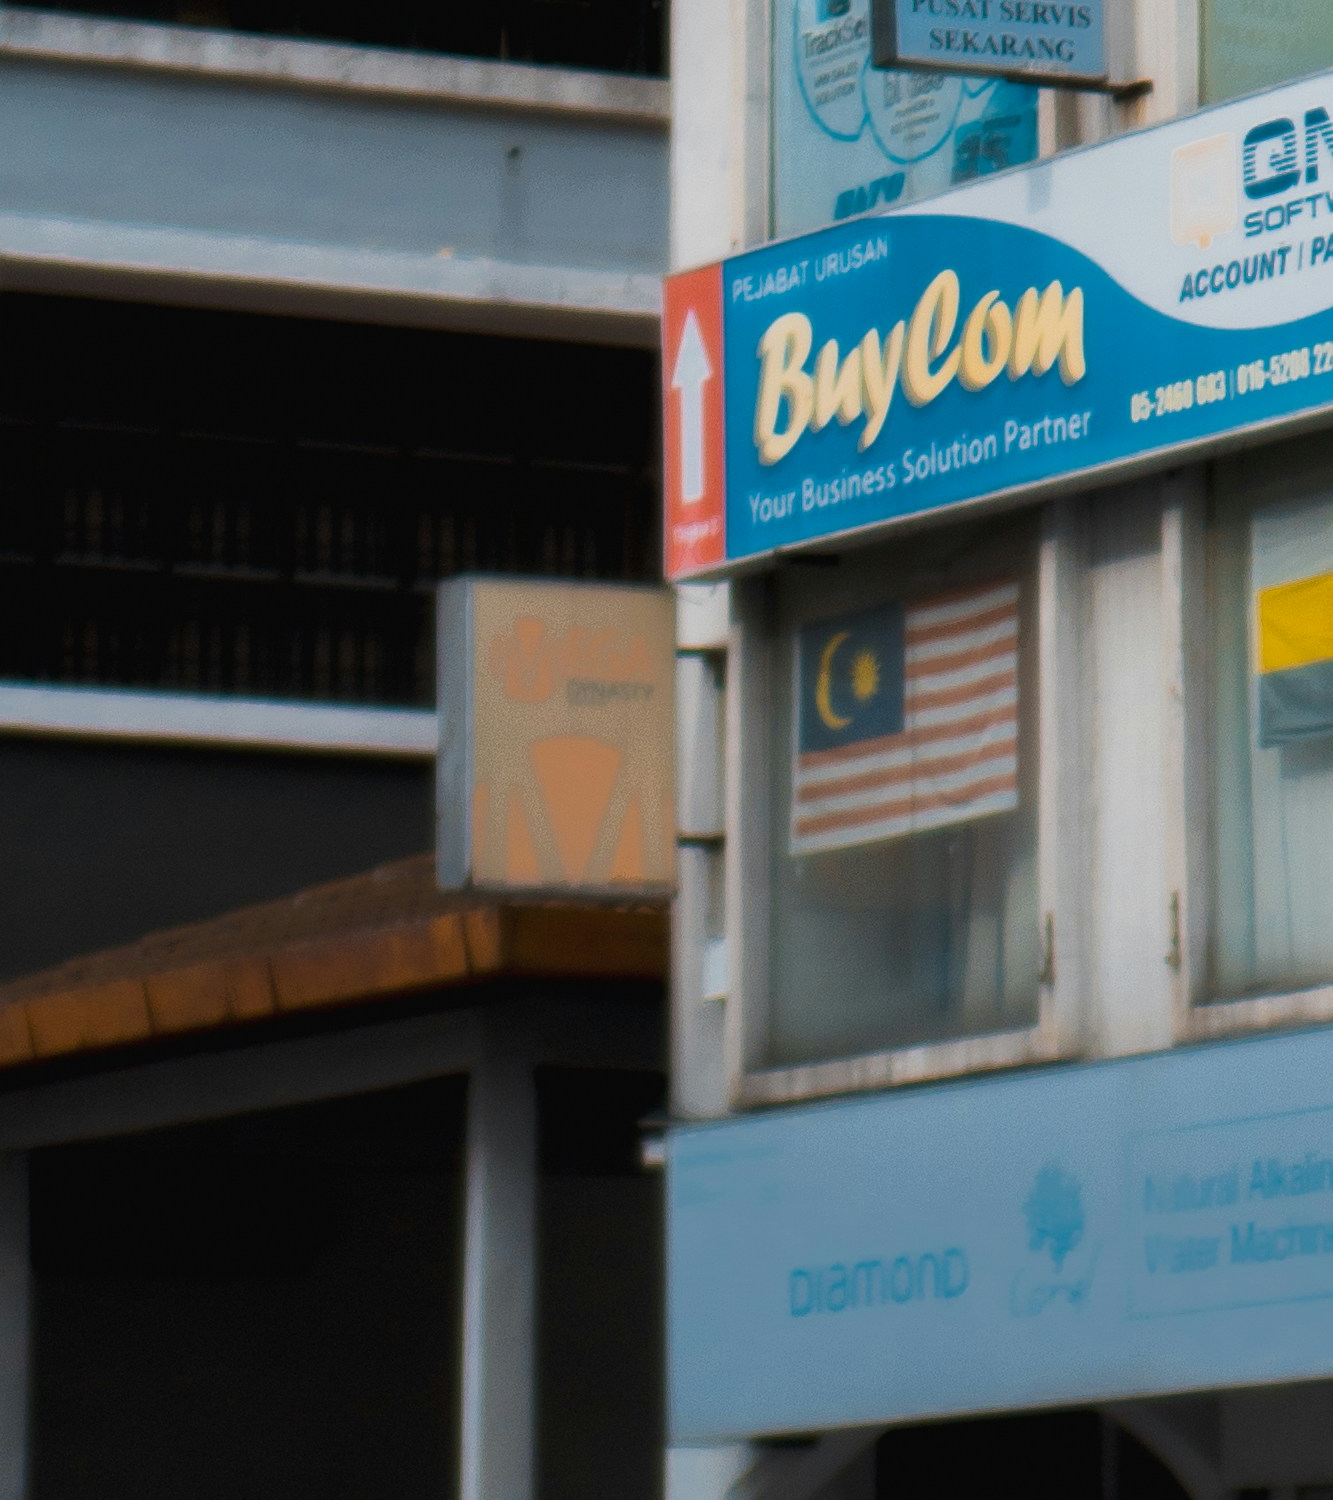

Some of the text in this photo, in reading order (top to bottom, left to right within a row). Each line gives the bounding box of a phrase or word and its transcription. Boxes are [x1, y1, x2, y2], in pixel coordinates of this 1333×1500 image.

[929, 26, 1076, 64] SEKARANG
[732, 236, 889, 303] PEJABAT URUSAN
[1179, 244, 1291, 303] ACCOUNT
[754, 269, 1087, 467] BuyCom
[748, 409, 1092, 525] Your Business Solution Partner
